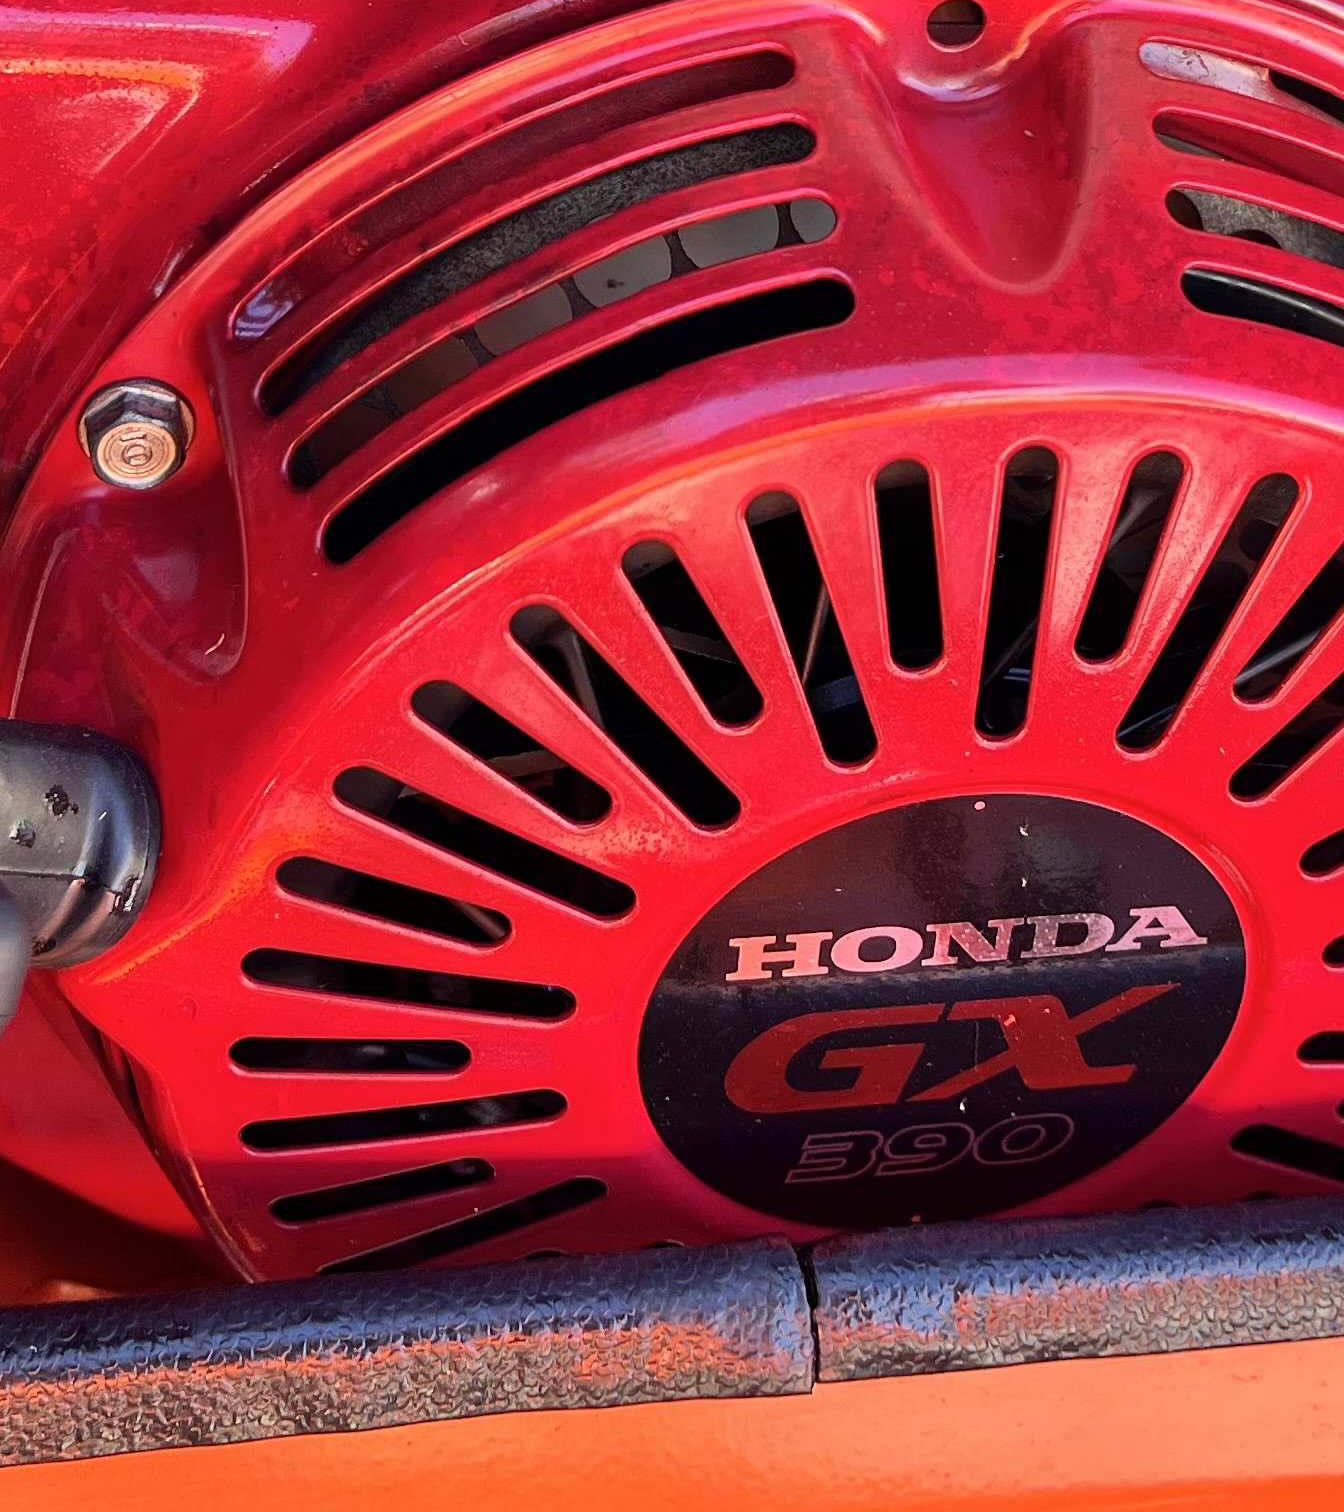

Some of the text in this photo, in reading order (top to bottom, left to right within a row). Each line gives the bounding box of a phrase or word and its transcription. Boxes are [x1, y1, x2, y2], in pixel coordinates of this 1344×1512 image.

[725, 905, 1208, 982] HONDA
[723, 983, 1180, 1114] GX
[785, 1114, 1074, 1184] 390
